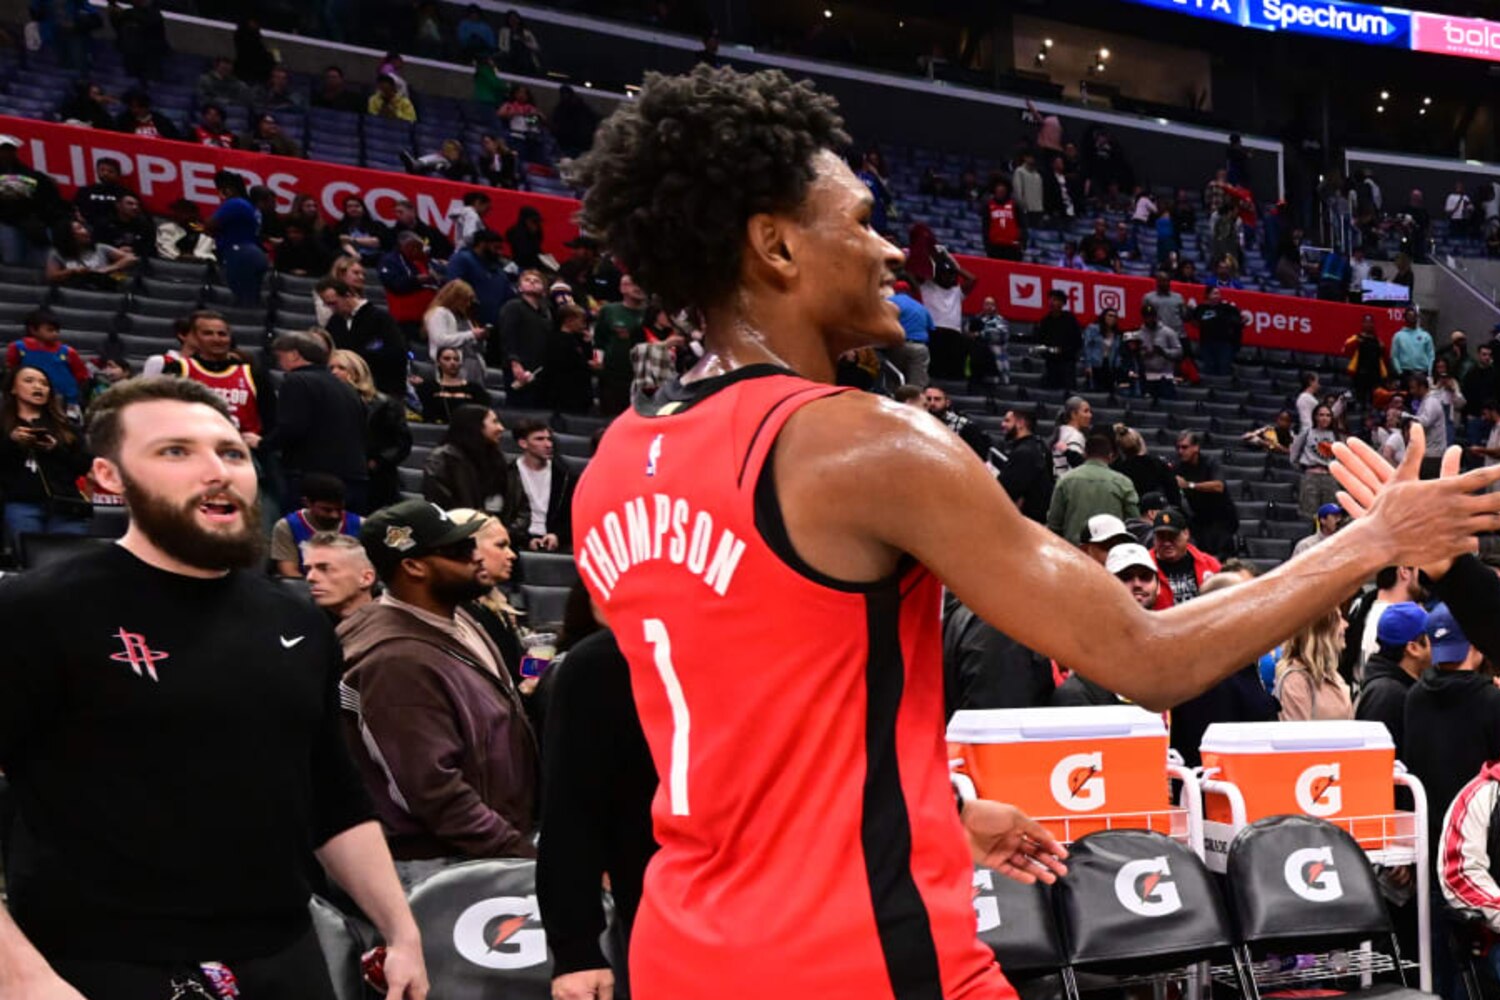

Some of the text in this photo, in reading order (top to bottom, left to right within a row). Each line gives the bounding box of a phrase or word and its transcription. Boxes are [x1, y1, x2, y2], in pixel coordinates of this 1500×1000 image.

[1262, 0, 1387, 36] Spectrum
[579, 494, 747, 601] THOMPSON
[642, 618, 692, 816] 1
[1049, 752, 1106, 812] G
[1294, 763, 1343, 818] G
[1114, 855, 1183, 918] G
[1283, 846, 1344, 903] G
[453, 894, 548, 970] G
